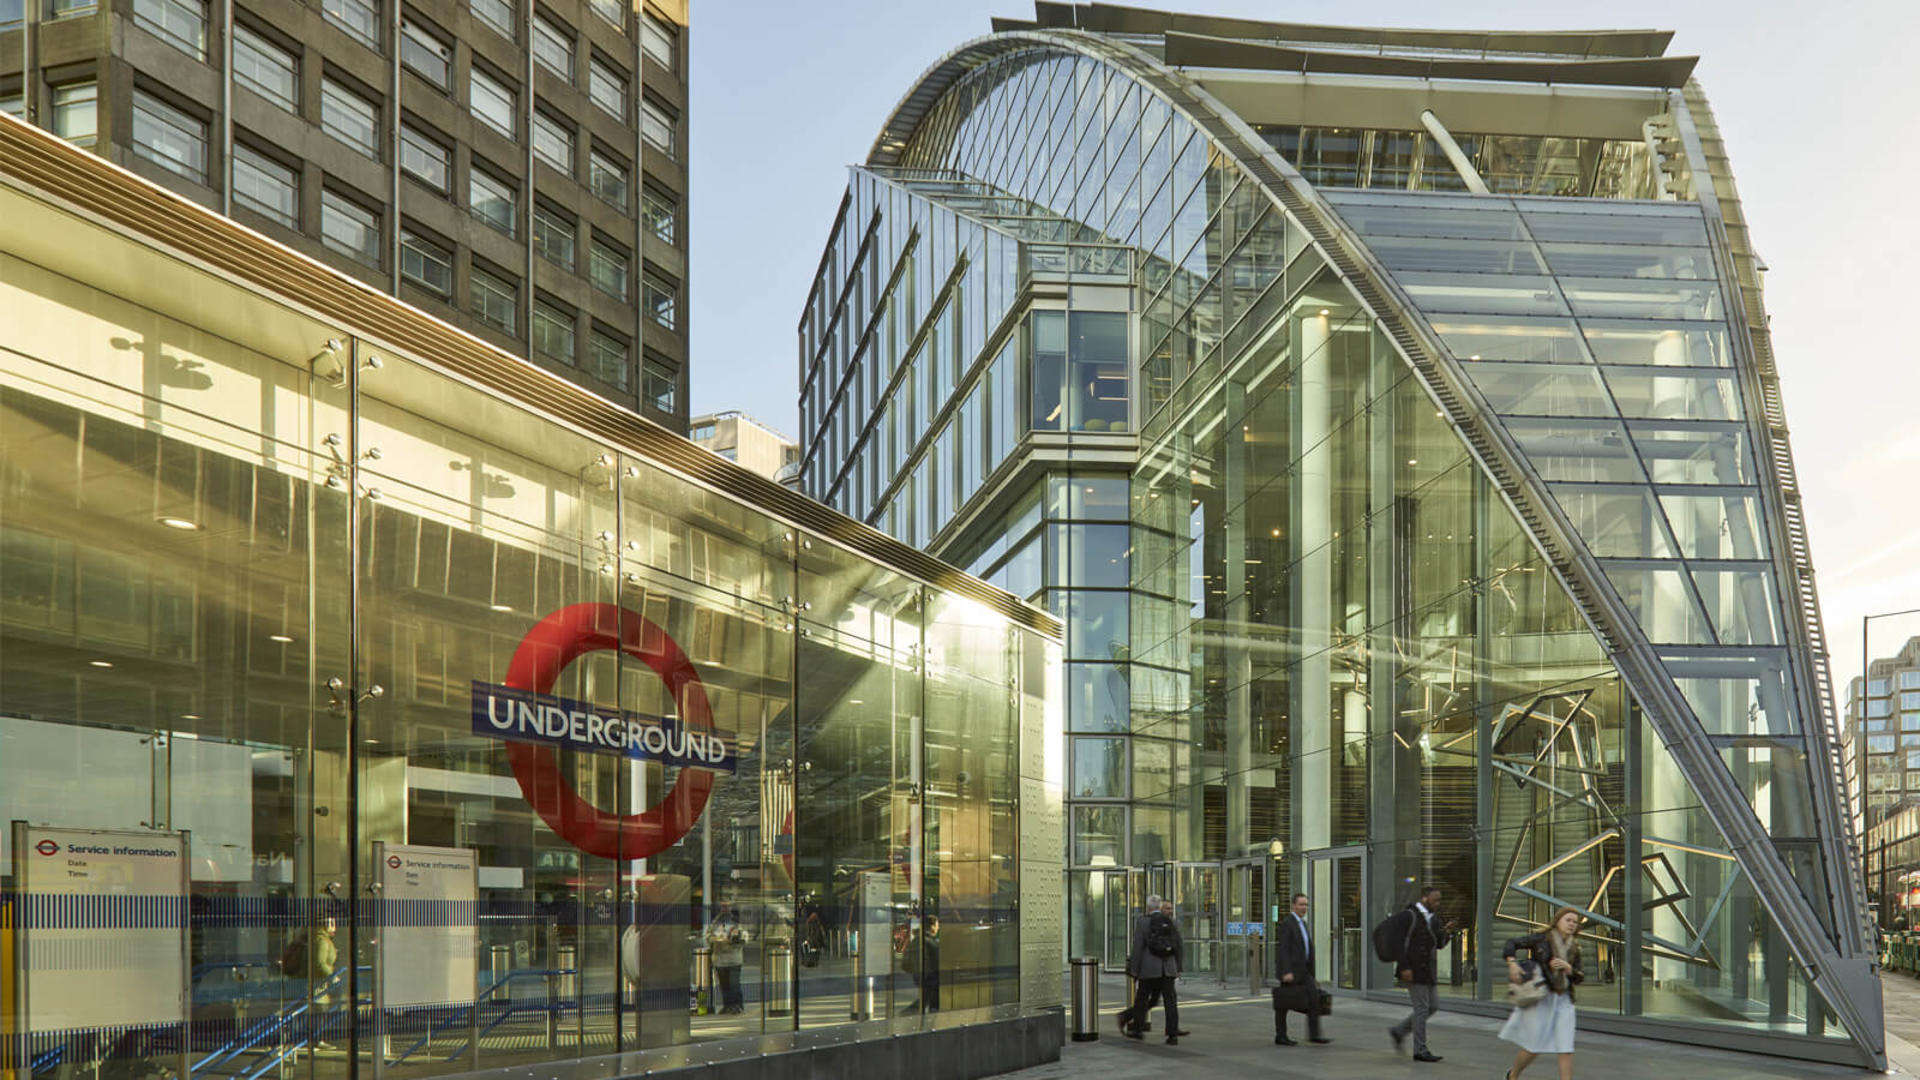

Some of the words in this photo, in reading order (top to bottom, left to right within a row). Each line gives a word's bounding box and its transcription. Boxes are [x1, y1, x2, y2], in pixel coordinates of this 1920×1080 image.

[487, 695, 726, 764] UNDERGROUND
[68, 844, 110, 855] Service
[114, 846, 177, 857] information
